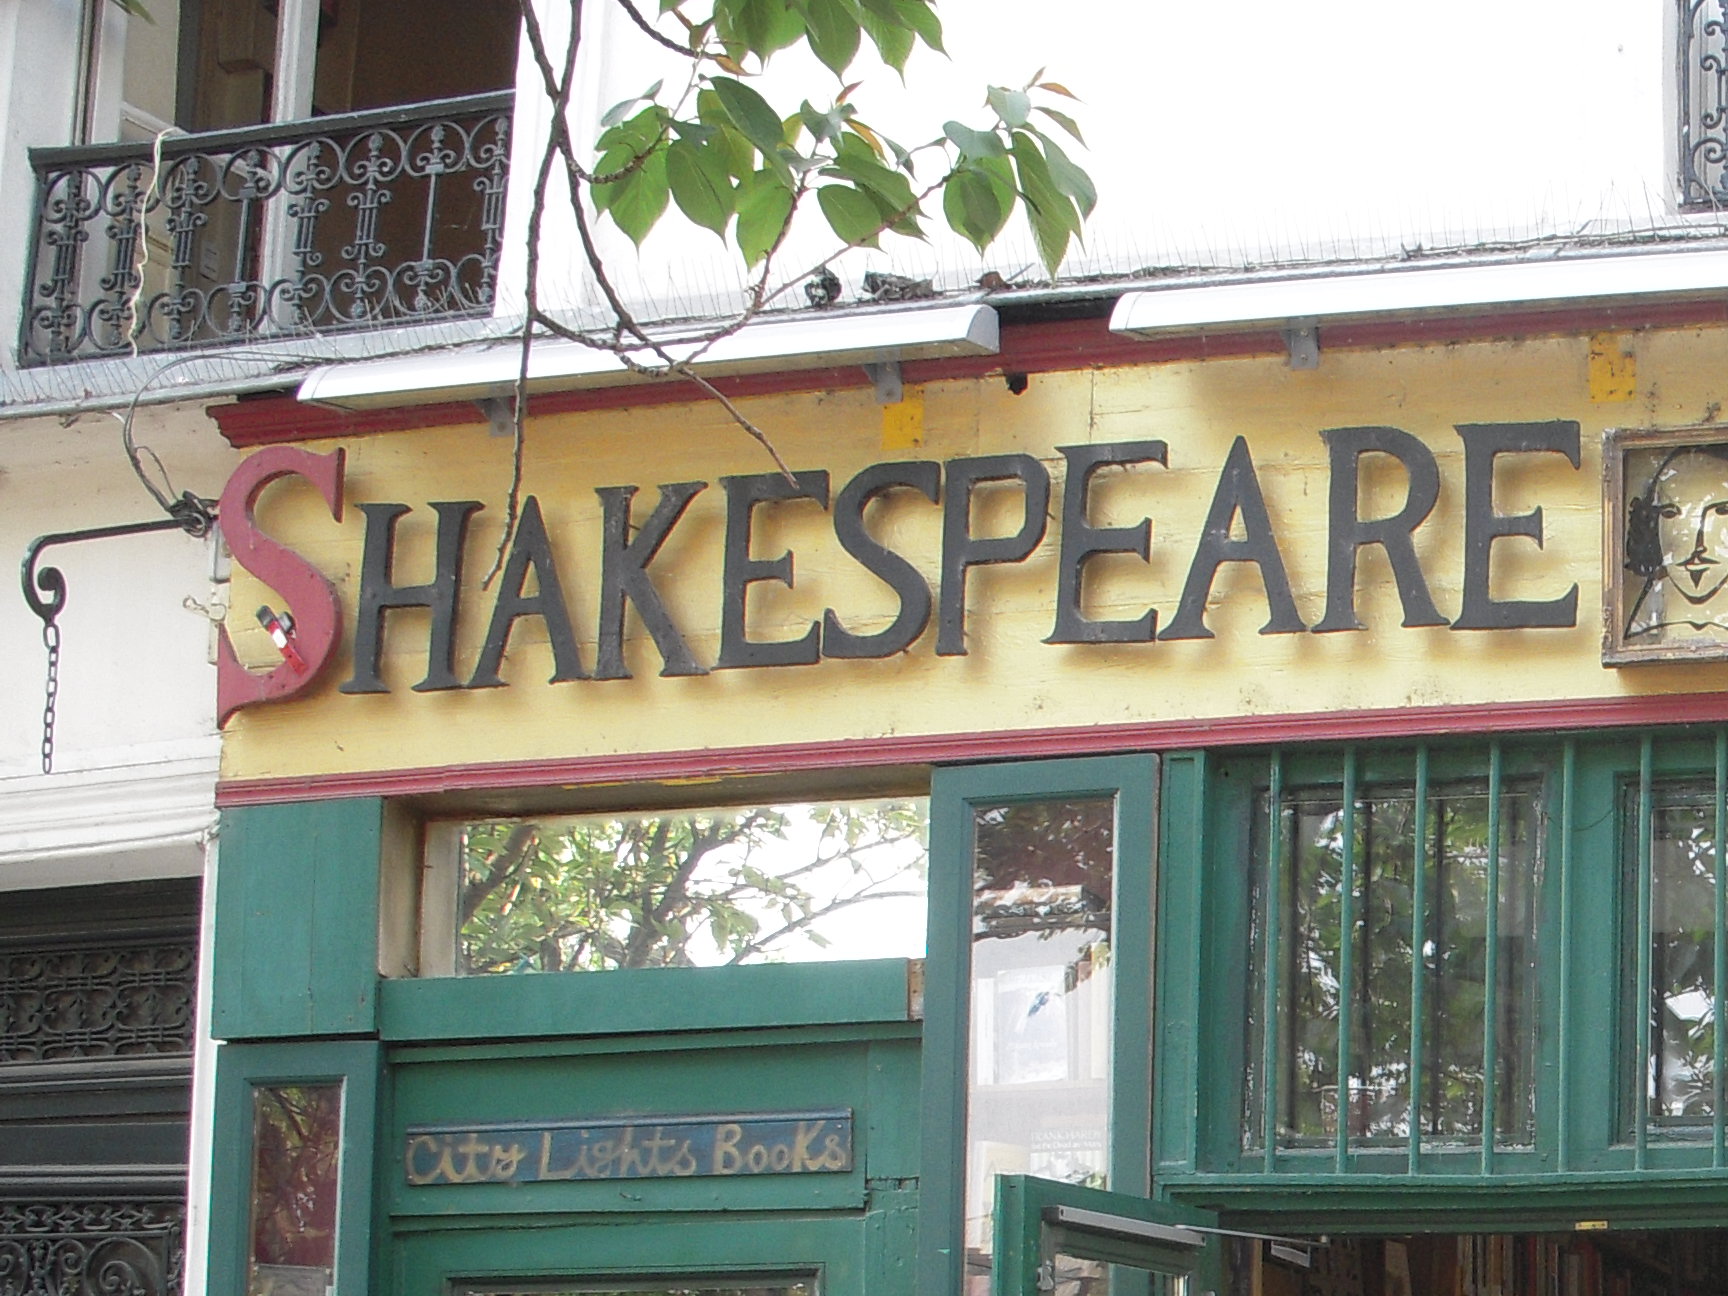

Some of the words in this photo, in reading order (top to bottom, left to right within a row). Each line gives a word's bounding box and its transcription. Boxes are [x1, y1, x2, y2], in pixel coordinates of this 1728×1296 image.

[215, 420, 1582, 730] SHAKESPEARE
[406, 1131, 525, 1184] City
[537, 1124, 697, 1180] Lights
